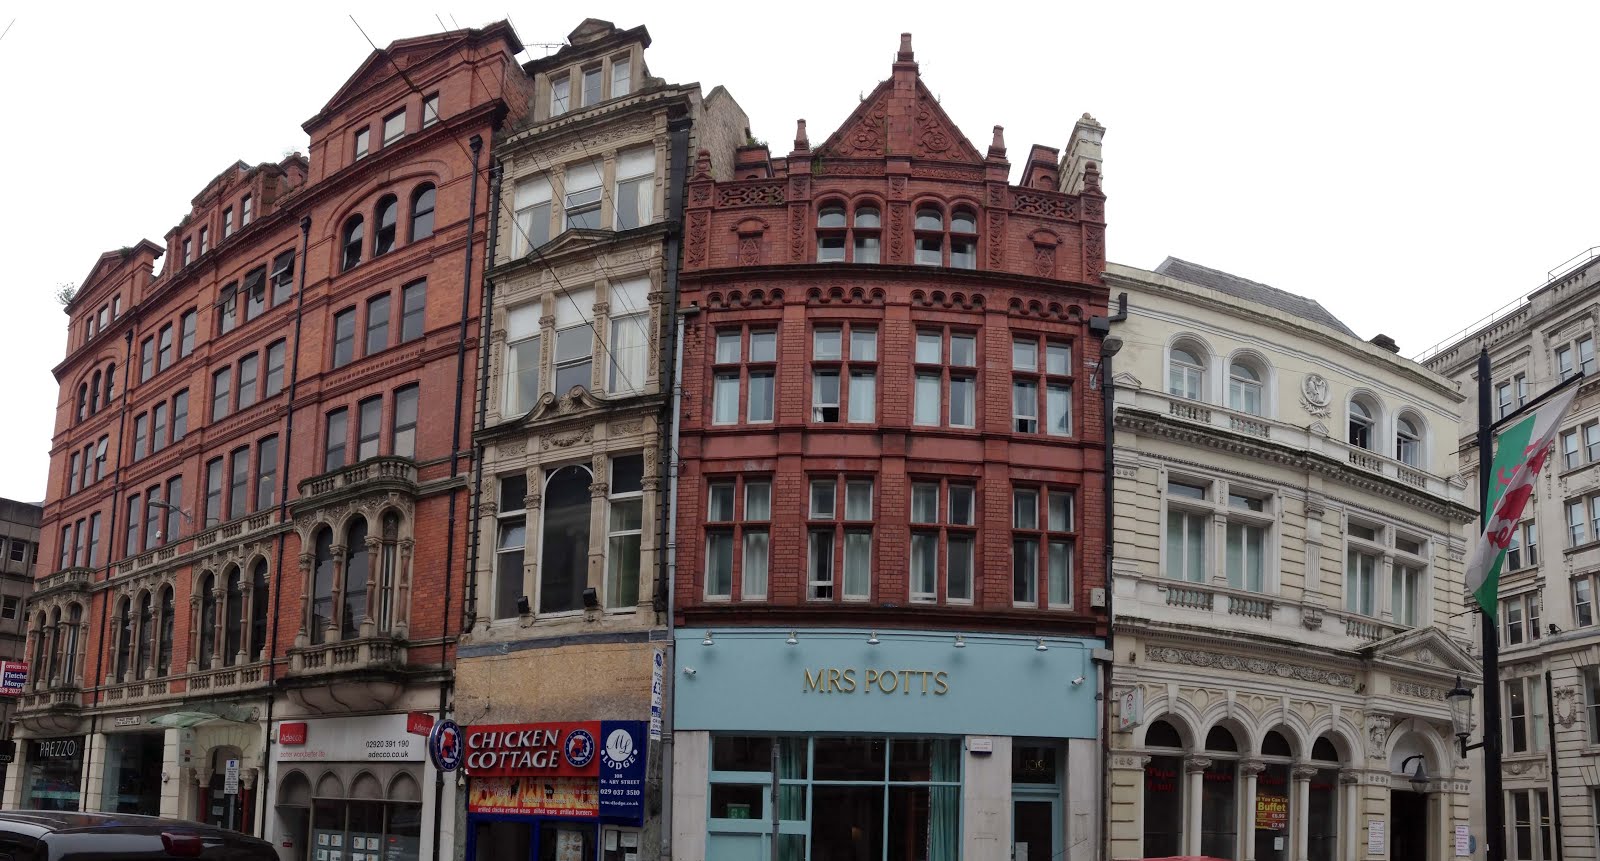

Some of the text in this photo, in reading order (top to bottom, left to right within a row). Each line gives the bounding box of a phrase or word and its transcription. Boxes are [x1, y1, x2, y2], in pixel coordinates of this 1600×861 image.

[802, 668, 949, 695] MRS POTTS
[281, 734, 303, 742] Adecco
[366, 739, 410, 748] 02920 391 190
[468, 729, 559, 749] CHICKEN
[40, 740, 76, 757] PREZZO
[467, 750, 559, 769] COTTAGE
[602, 754, 636, 770] LODGE
[1258, 802, 1286, 812] Buffet
